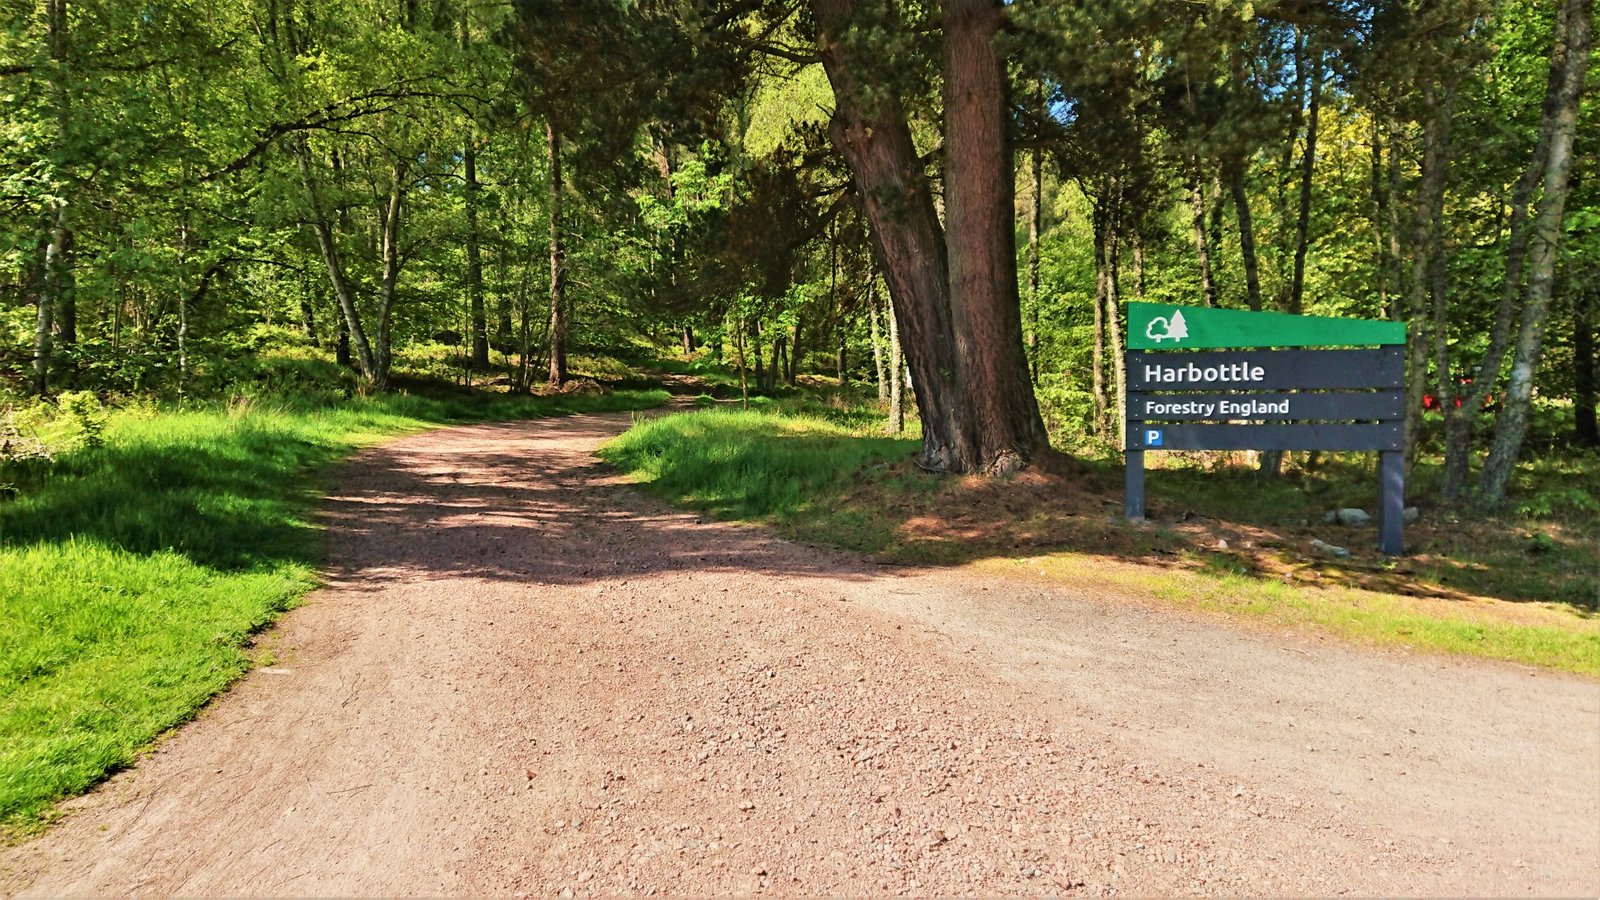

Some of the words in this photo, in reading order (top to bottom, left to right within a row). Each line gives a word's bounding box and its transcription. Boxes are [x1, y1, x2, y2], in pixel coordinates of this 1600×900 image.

[1145, 362, 1265, 383] Harbottle
[1145, 401, 1215, 417] Forestry
[1220, 399, 1290, 417] England
[1148, 431, 1160, 444] P
